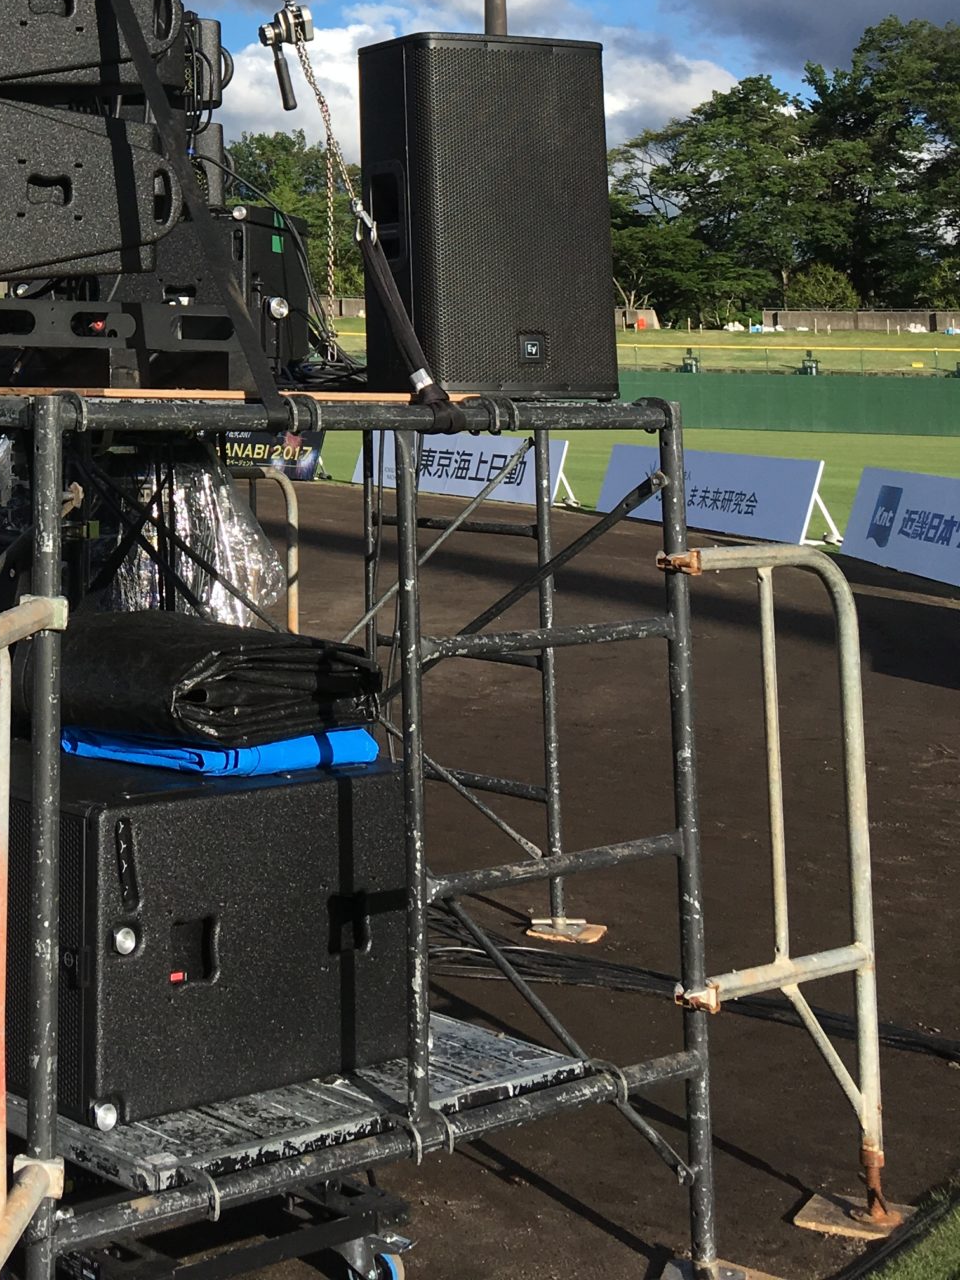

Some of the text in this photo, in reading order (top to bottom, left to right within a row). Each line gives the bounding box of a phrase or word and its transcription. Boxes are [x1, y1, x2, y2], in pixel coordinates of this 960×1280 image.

[874, 506, 894, 527] Knt
[897, 509, 960, 549] 近畿日本
